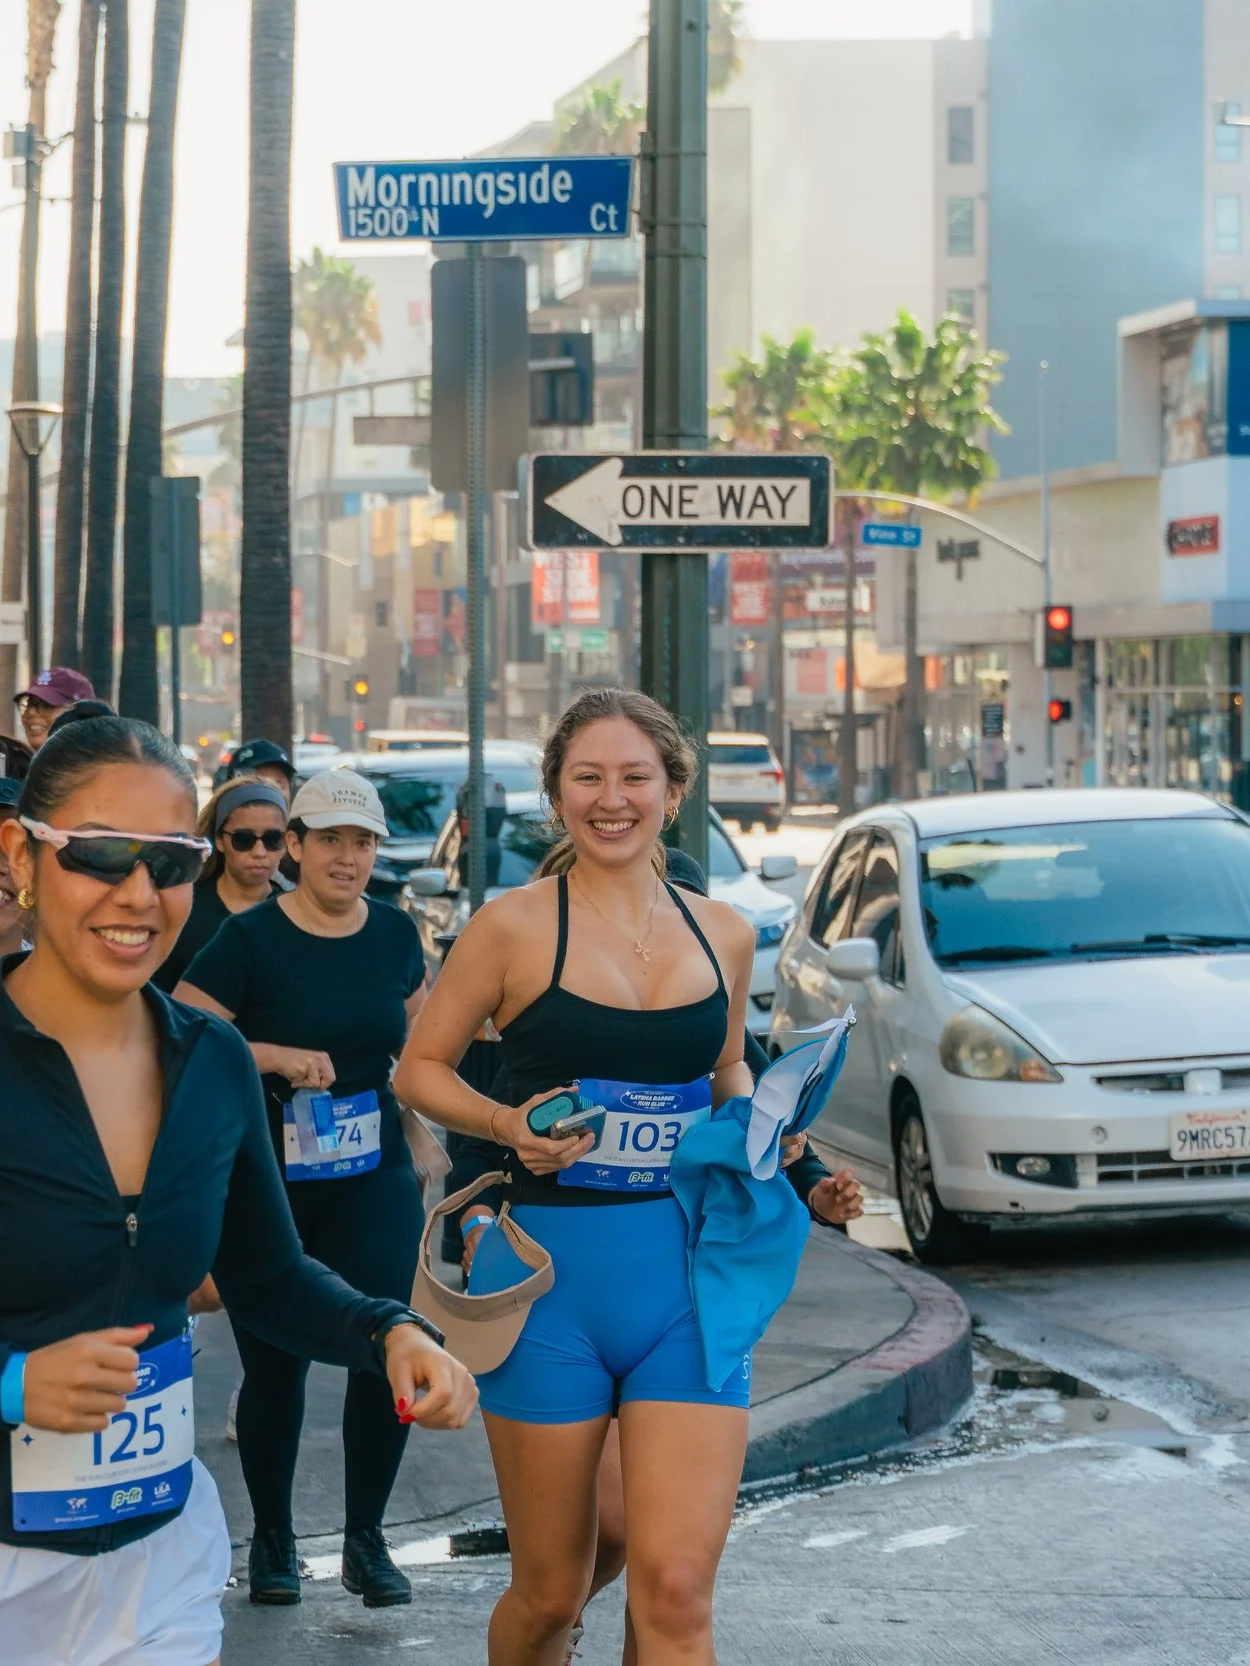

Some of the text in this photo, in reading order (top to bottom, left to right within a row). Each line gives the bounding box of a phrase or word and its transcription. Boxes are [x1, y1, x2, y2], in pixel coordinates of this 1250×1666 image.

[347, 164, 573, 219] Morningside
[349, 207, 440, 237] 1500 N
[589, 201, 619, 232] Ct
[621, 484, 798, 520] ONE WAY
[618, 1120, 683, 1153] 103
[1177, 1125, 1250, 1153] 9MRC57
[93, 1402, 166, 1466] 125
